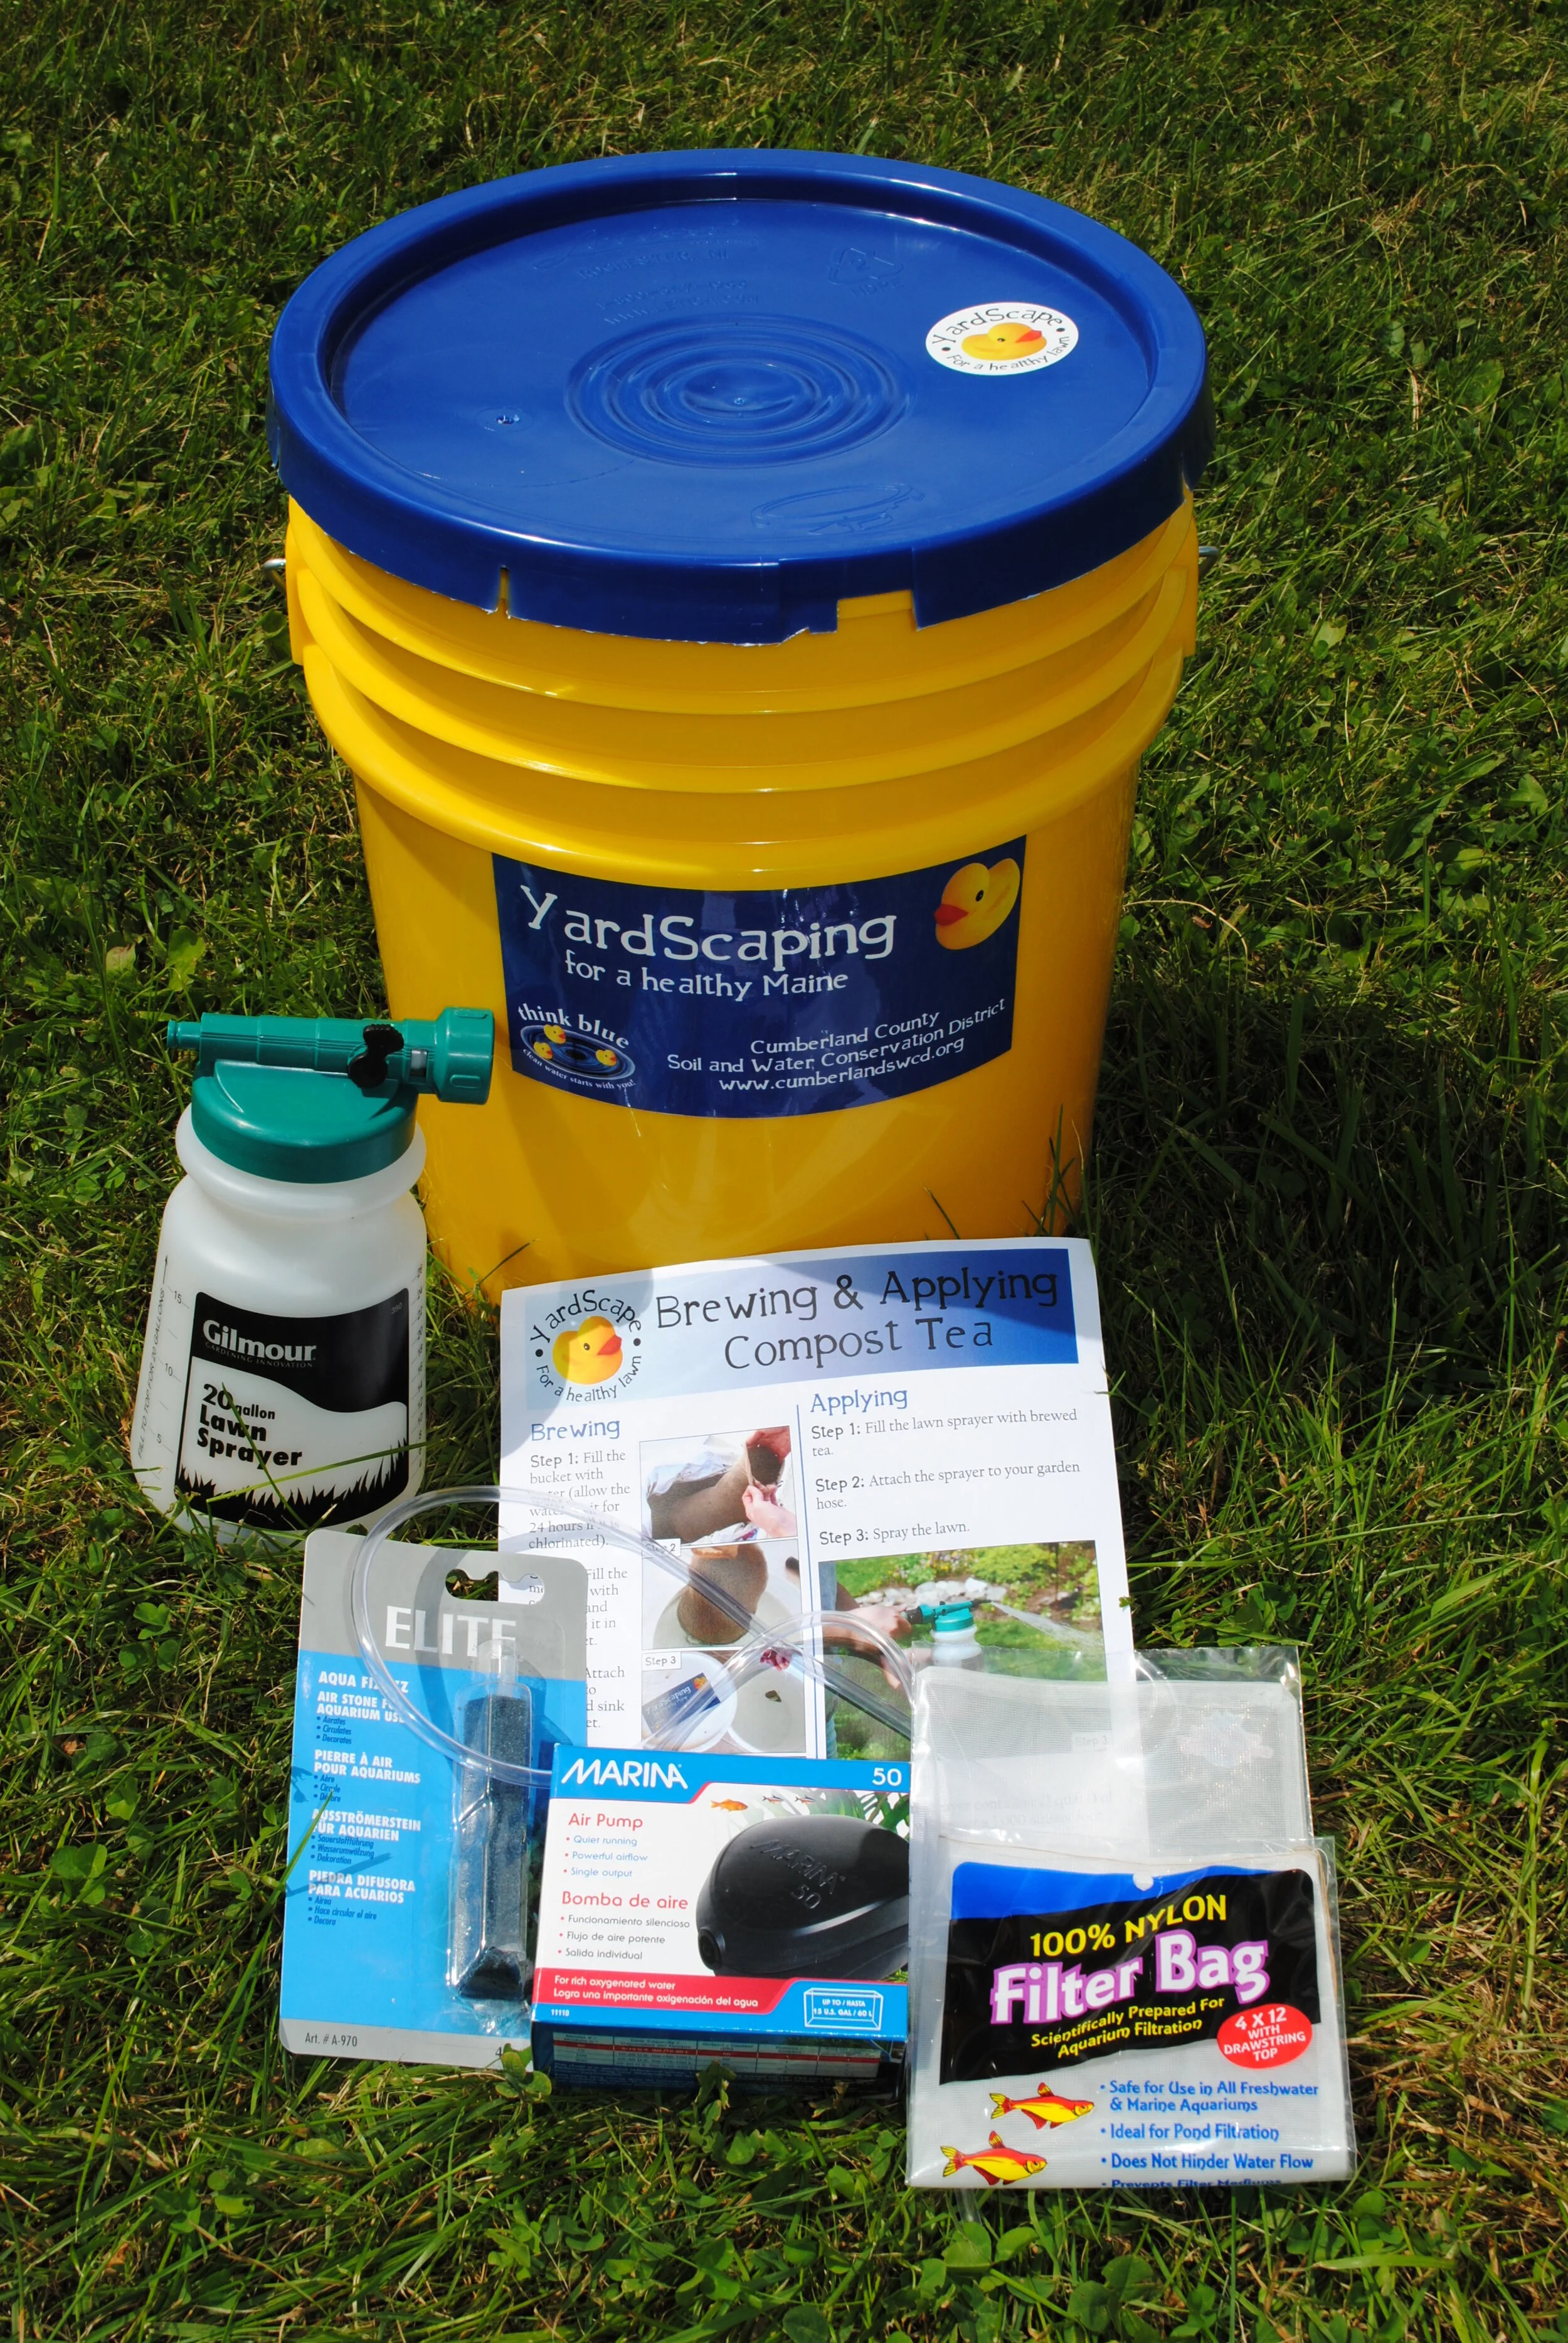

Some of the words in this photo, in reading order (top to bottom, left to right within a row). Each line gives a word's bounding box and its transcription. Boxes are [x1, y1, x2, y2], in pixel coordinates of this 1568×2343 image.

[932, 308, 1062, 344] YardScape
[947, 354, 970, 368] For
[989, 355, 1049, 371] healthy
[1047, 336, 1069, 356] lawn
[519, 885, 897, 971] YardScaping
[564, 950, 606, 982] for
[616, 970, 631, 986] a
[642, 969, 753, 1002] healthy
[763, 971, 848, 996] Maine
[518, 1003, 572, 1027] think
[578, 1014, 630, 1048] blue
[667, 1055, 702, 1071] Soil
[709, 1058, 743, 1073] and
[751, 1058, 813, 1072] Water
[820, 1028, 945, 1068] Conservation
[948, 999, 1005, 1035] District
[750, 1028, 869, 1055] Cumberland
[874, 1012, 940, 1039] County
[522, 1048, 543, 1066] clean
[545, 1066, 568, 1080] water
[570, 1077, 593, 1087] starts
[719, 1037, 965, 1090] www.cumberlandswcd.org
[174, 1290, 182, 1304] 15
[657, 1283, 817, 1330] Brewing
[834, 1275, 864, 1310] &
[879, 1267, 1058, 1310] Applying
[530, 1290, 642, 1343] YardScape
[203, 1319, 317, 1361] Gilmour
[724, 1322, 903, 1371] Compost
[915, 1317, 993, 1351] Tea
[165, 1363, 173, 1376] 10
[257, 1359, 312, 1368] INNOVATION
[536, 1365, 554, 1388] For
[554, 1386, 564, 1396] a
[566, 1385, 617, 1402] healthy
[618, 1356, 642, 1388] lawn
[203, 1383, 233, 1410] 20
[810, 1389, 908, 1415] Applying
[200, 1403, 267, 1442] Lawn
[531, 1420, 620, 1441] Brewing
[811, 1424, 844, 1439] Step
[849, 1422, 861, 1435] 1:
[866, 1420, 886, 1433] Fill
[889, 1418, 909, 1432] the
[913, 1418, 944, 1430] lawn
[947, 1414, 993, 1430] sprayer
[997, 1410, 1027, 1424] with
[1030, 1409, 1078, 1422] brewed
[156, 1433, 162, 1443] 5
[197, 1427, 302, 1470] Sprayer
[531, 1455, 562, 1469] Step
[568, 1452, 578, 1464] 1:
[584, 1451, 603, 1464] Fill
[607, 1450, 626, 1462] the
[812, 1446, 834, 1457] tea.
[530, 1471, 571, 1484] bucket
[575, 1467, 603, 1480] with
[816, 1477, 848, 1493] Step
[852, 1476, 865, 1489] 2:
[869, 1471, 911, 1487] Attach
[914, 1470, 935, 1482] the
[938, 1468, 985, 1484] sprayer
[988, 1467, 1002, 1477] to
[1005, 1464, 1034, 1479] your
[1037, 1460, 1080, 1477] garden
[817, 1497, 847, 1510] hose.
[820, 1530, 852, 1546] Step
[856, 1529, 869, 1541] 3:
[873, 1527, 908, 1543] Spray
[912, 1524, 932, 1536] the
[935, 1521, 970, 1534] lawn.
[319, 1671, 356, 1687] AQUA
[318, 1691, 337, 1703] AIR
[342, 1693, 378, 1708] STONE
[316, 1703, 380, 1721] AQUARIUM
[322, 1734, 352, 1745] Decorates
[323, 1724, 351, 1735] Circulates
[314, 1749, 356, 1763] PIERRE
[372, 1756, 393, 1768] AIR
[314, 1761, 346, 1775] POUR
[351, 1766, 421, 1784] AQUARIUMS
[561, 1758, 688, 1789] MARINA
[872, 1768, 902, 1786] 50
[568, 1813, 591, 1826] Air
[596, 1813, 643, 1831] Pump
[574, 1835, 599, 1844] Quiet
[603, 1837, 637, 1847] running
[572, 1851, 613, 1861] Powerful
[616, 1852, 648, 1861] airflow
[309, 1870, 352, 1884] PIEDRA
[357, 1875, 415, 1891] DIFUSORA
[571, 1867, 598, 1878] Single
[602, 1870, 632, 1878] output
[309, 1883, 341, 1896] PARA
[345, 1888, 404, 1904] ACUARIOS
[562, 1891, 622, 1906] Bomba
[629, 1894, 650, 1908] de
[657, 1896, 688, 1910] aire
[790, 1886, 821, 1910] 50
[568, 1915, 642, 1926] Funcionamiento
[645, 1917, 690, 1928] silencioso
[1030, 1923, 1115, 1957] 100%
[1125, 1894, 1227, 1943] NYLON
[566, 1931, 588, 1942] Flujo
[591, 1932, 603, 1941] de
[607, 1933, 625, 1942] aire
[628, 1934, 665, 1944] potente
[566, 1948, 594, 1958] Salida
[597, 1950, 642, 1960] individual
[554, 1975, 569, 1984] For
[571, 1976, 587, 1985] rich
[590, 1979, 645, 1989] oxygenated
[991, 1957, 1143, 2024] Filter
[1154, 1929, 1268, 2005] Bag
[554, 1988, 580, 1999] Logra
[583, 1991, 600, 1999] una
[603, 1992, 654, 2002] importante
[657, 1994, 713, 2006] oxigenación
[716, 1997, 731, 2006] del
[733, 1999, 758, 2008] agua
[1031, 2011, 1124, 2048] Scientifically
[1129, 2002, 1197, 2020] Prepared
[1200, 1997, 1224, 2012] For
[1236, 2016, 1248, 2030] 4
[1252, 2012, 1264, 2026] X
[1269, 2007, 1286, 2023] 12
[305, 2032, 319, 2044] Art.
[331, 2034, 358, 2046] A-970
[1058, 2028, 1130, 2058] Aquarium
[1135, 2019, 1202, 2037] Filtration
[1248, 2025, 1280, 2039] WITH
[1224, 2032, 1306, 2054] DRAWSTRING
[1253, 2048, 1278, 2061] TOP
[1110, 2081, 1140, 2095] Safe
[1144, 2081, 1163, 2093] for
[1168, 2081, 1195, 2095] Use
[1199, 2082, 1212, 2096] in
[1217, 2081, 1236, 2093] All
[1240, 2082, 1319, 2096] Freshwater
[1110, 2098, 1123, 2111] &
[1127, 2098, 1176, 2112] Marine
[1180, 2098, 1258, 2115] Aquariums
[1111, 2124, 1145, 2138] Ideal
[1149, 2125, 1170, 2138] for
[1174, 2124, 1211, 2140] Pond
[1216, 2124, 1279, 2141] Filtration
[1111, 2153, 1147, 2169] Does
[1151, 2153, 1177, 2169] Not
[1182, 2153, 1229, 2170] Hinder
[1233, 2153, 1276, 2169] Water
[1279, 2154, 1313, 2169] Flow
